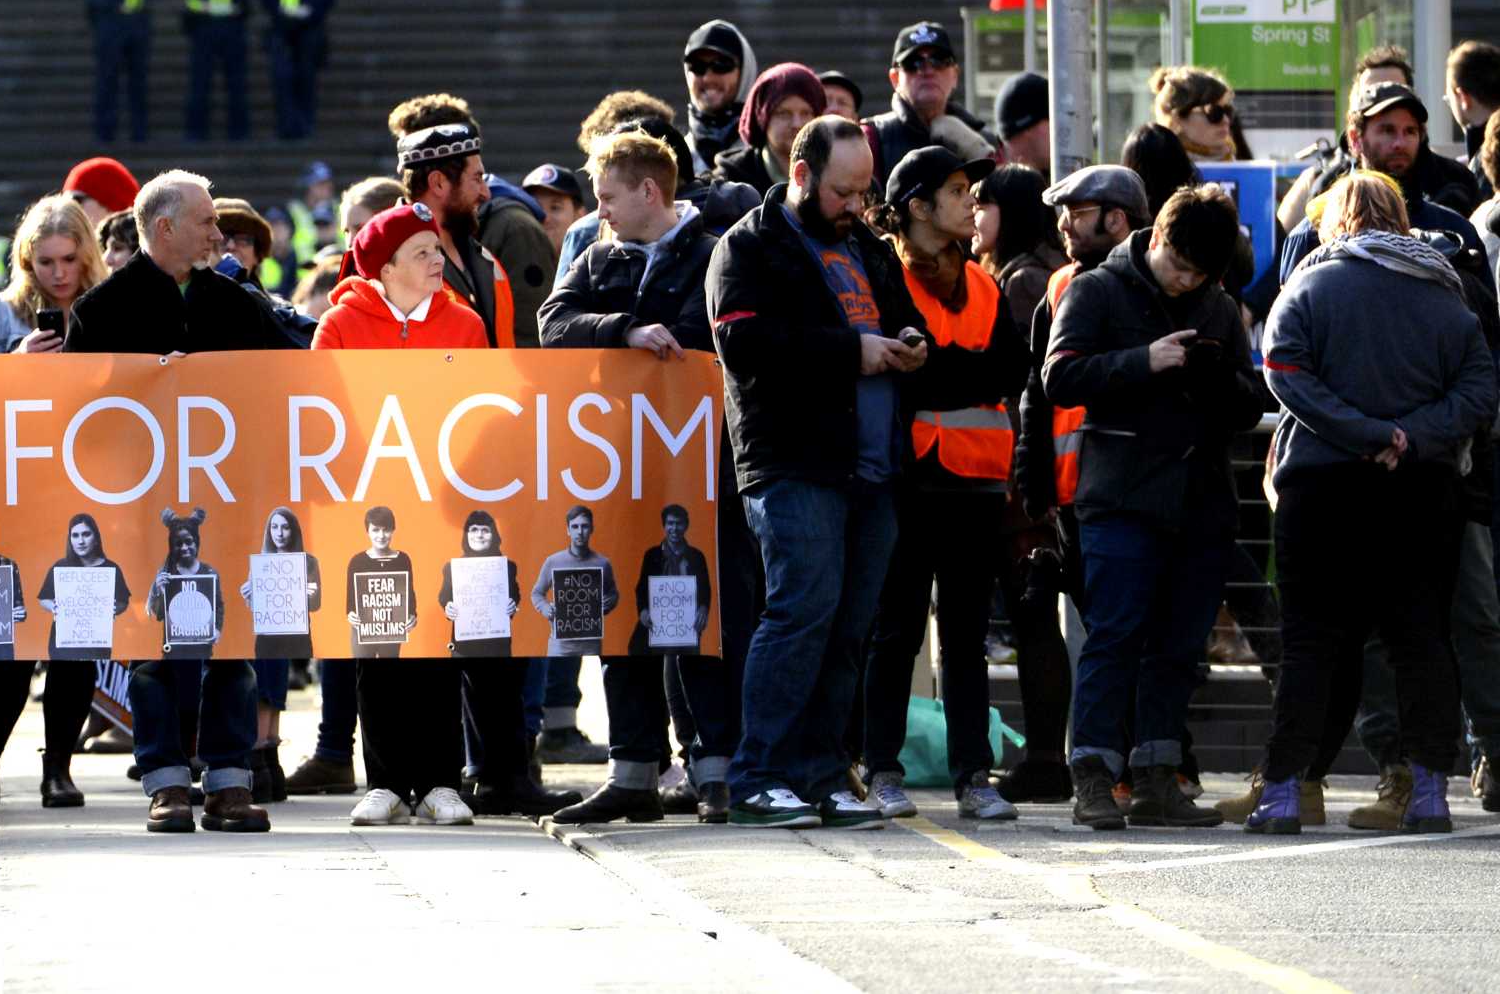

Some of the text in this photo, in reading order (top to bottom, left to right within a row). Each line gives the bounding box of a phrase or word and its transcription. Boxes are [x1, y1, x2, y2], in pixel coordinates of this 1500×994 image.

[1251, 25, 1330, 46] Spring St
[5, 396, 237, 505] FOR
[288, 392, 715, 502] RACISM
[262, 559, 294, 575] #NO
[181, 581, 197, 593] NO
[256, 576, 302, 592] ROOM
[368, 578, 395, 593] FEAR
[564, 573, 592, 587] #NO
[659, 581, 686, 594] #NO
[266, 593, 293, 608] FOR
[362, 593, 401, 607] RACISM
[558, 588, 599, 603] ROOM
[653, 595, 692, 608] ROOM
[254, 609, 305, 625] RACISM
[372, 608, 392, 622] NOT
[566, 603, 591, 617] FOR
[661, 608, 685, 623] FOR
[171, 623, 210, 637] RACISM
[361, 622, 405, 636] MUSLIMS
[556, 617, 601, 632] RACISM
[651, 623, 693, 638] RACISM
